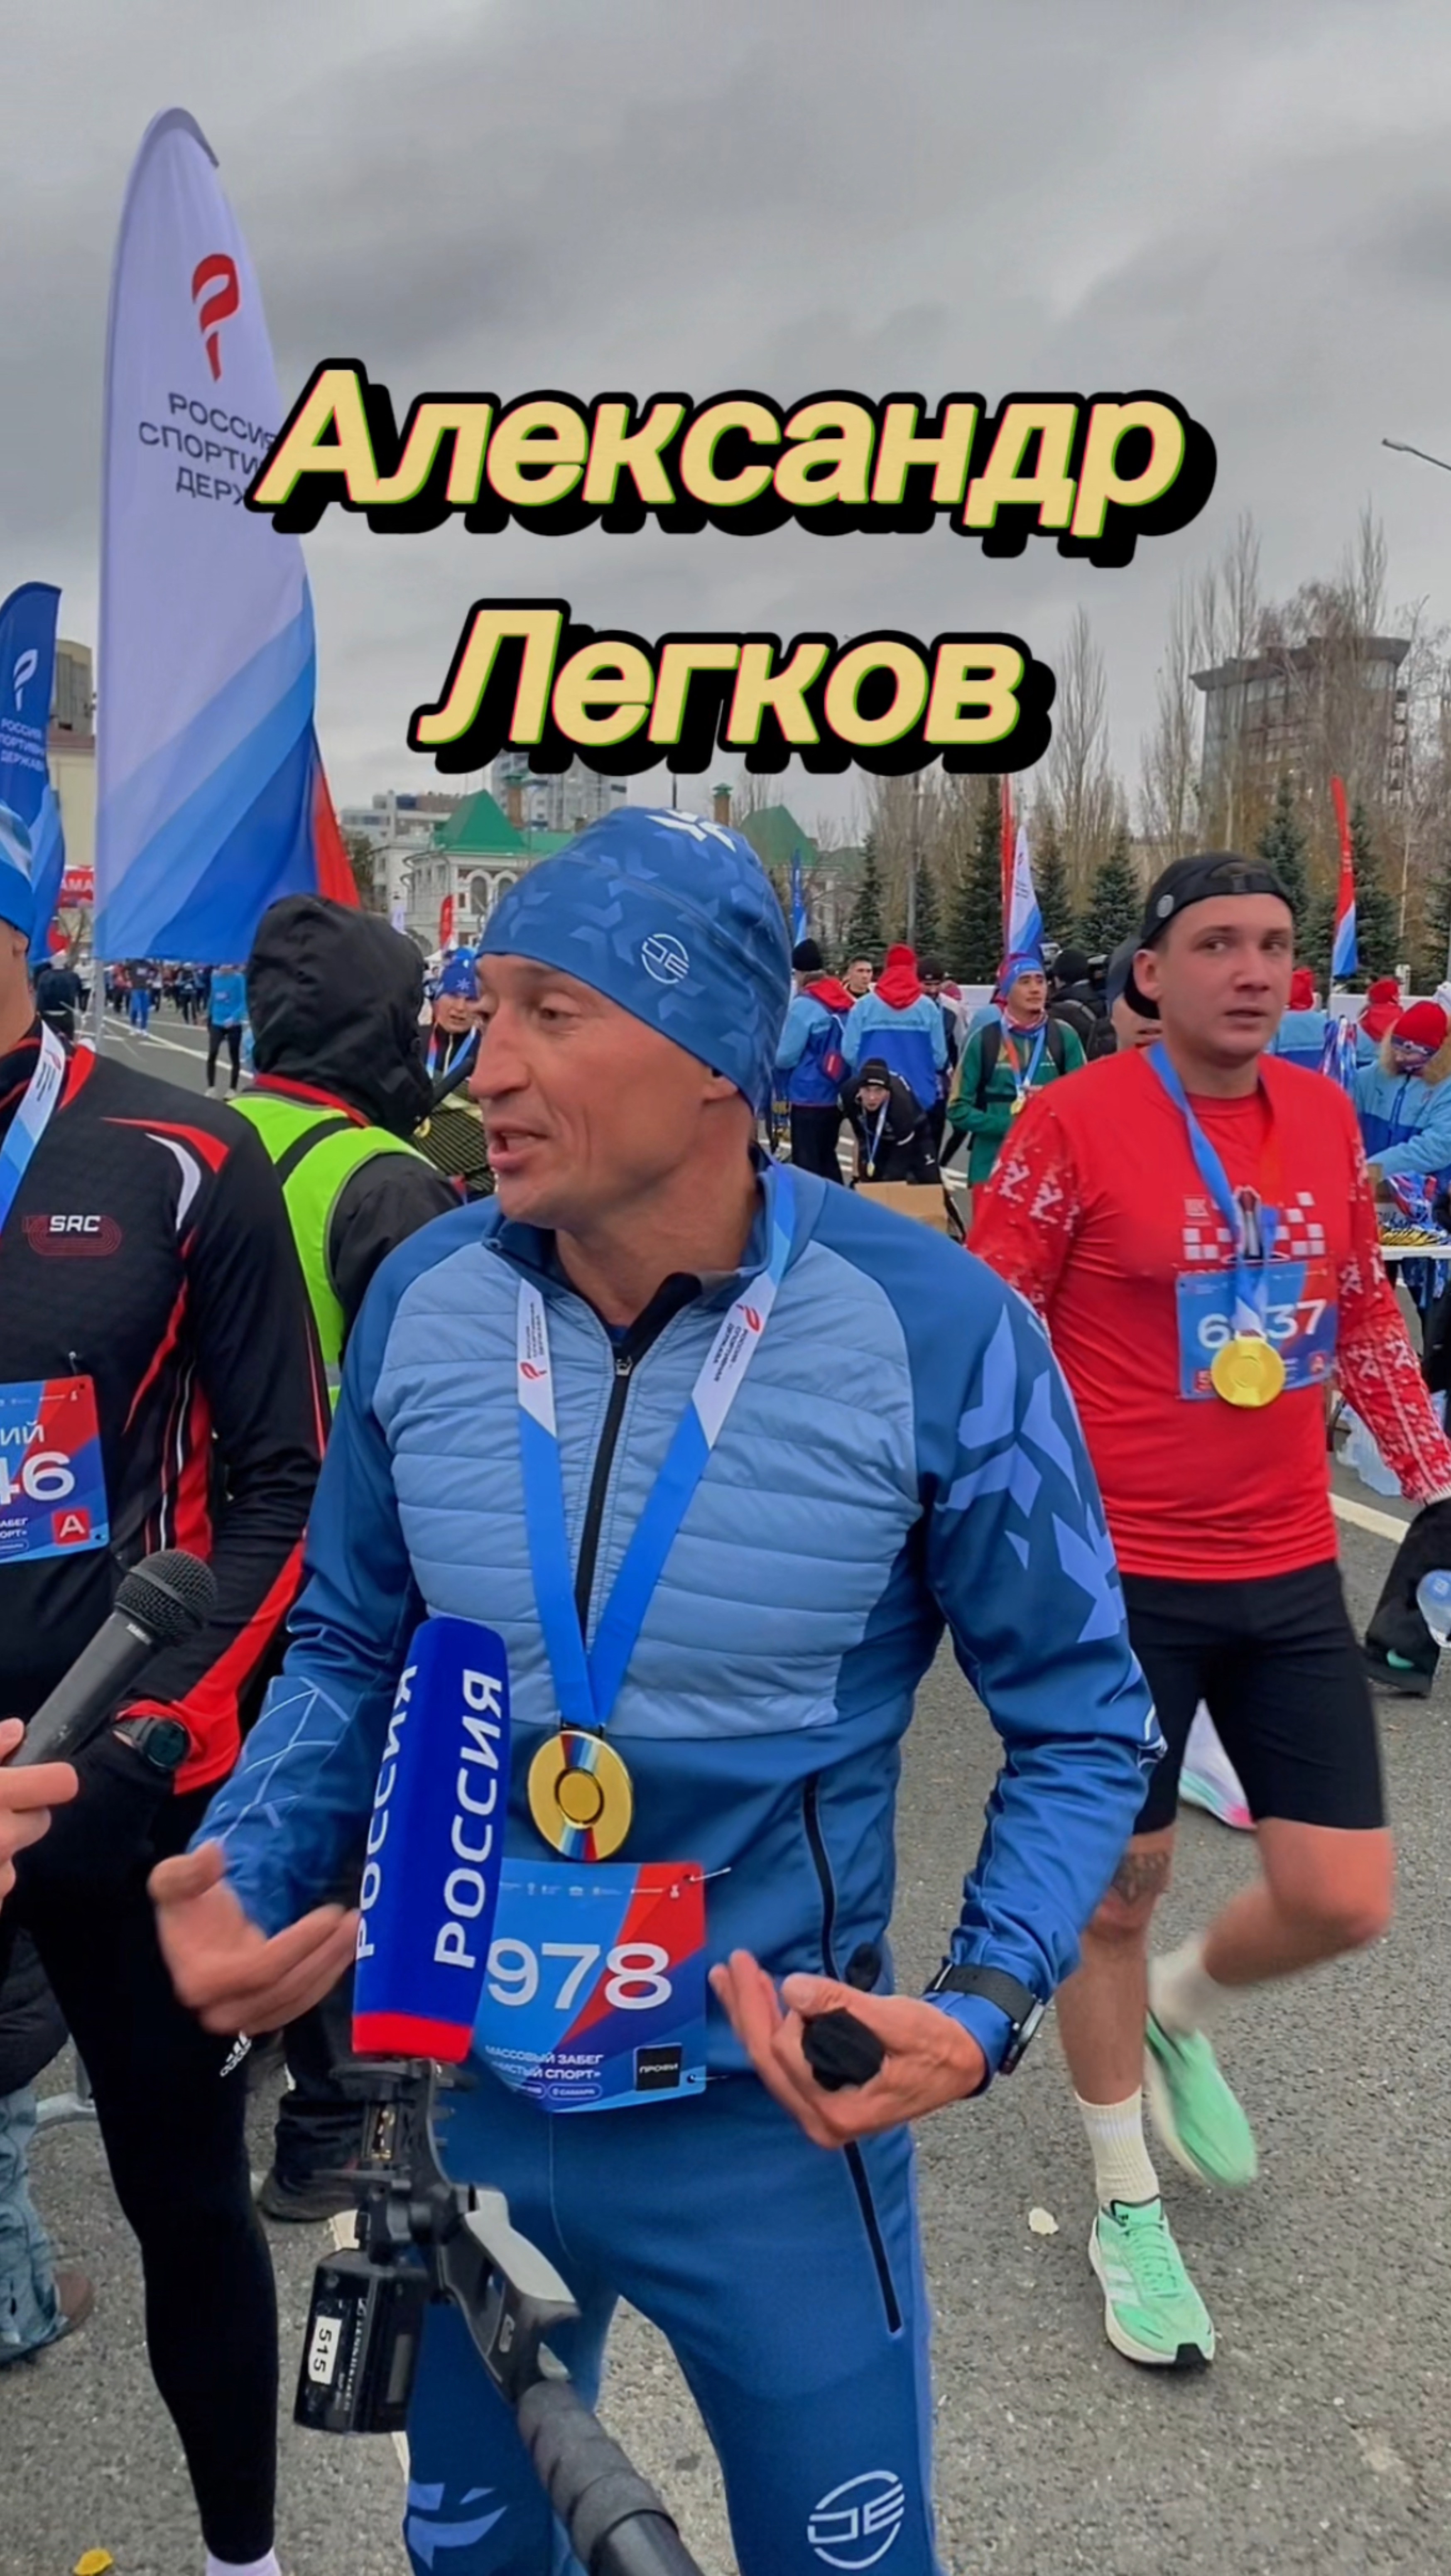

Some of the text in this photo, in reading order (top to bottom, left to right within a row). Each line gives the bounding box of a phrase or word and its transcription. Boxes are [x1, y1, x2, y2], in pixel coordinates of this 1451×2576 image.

[139, 421, 261, 475] СПОРТИ
[49, 1215, 100, 1232] SRC
[1197, 1299, 1328, 1349] 637
[0, 1420, 44, 1446] ИЙ
[0, 1517, 28, 1528] АБЕГ
[434, 1668, 503, 1969] РОССИЯ
[486, 1937, 673, 2010] 978
[557, 2053, 604, 2065] ЗАБЕГ
[313, 2328, 332, 2373] 515
